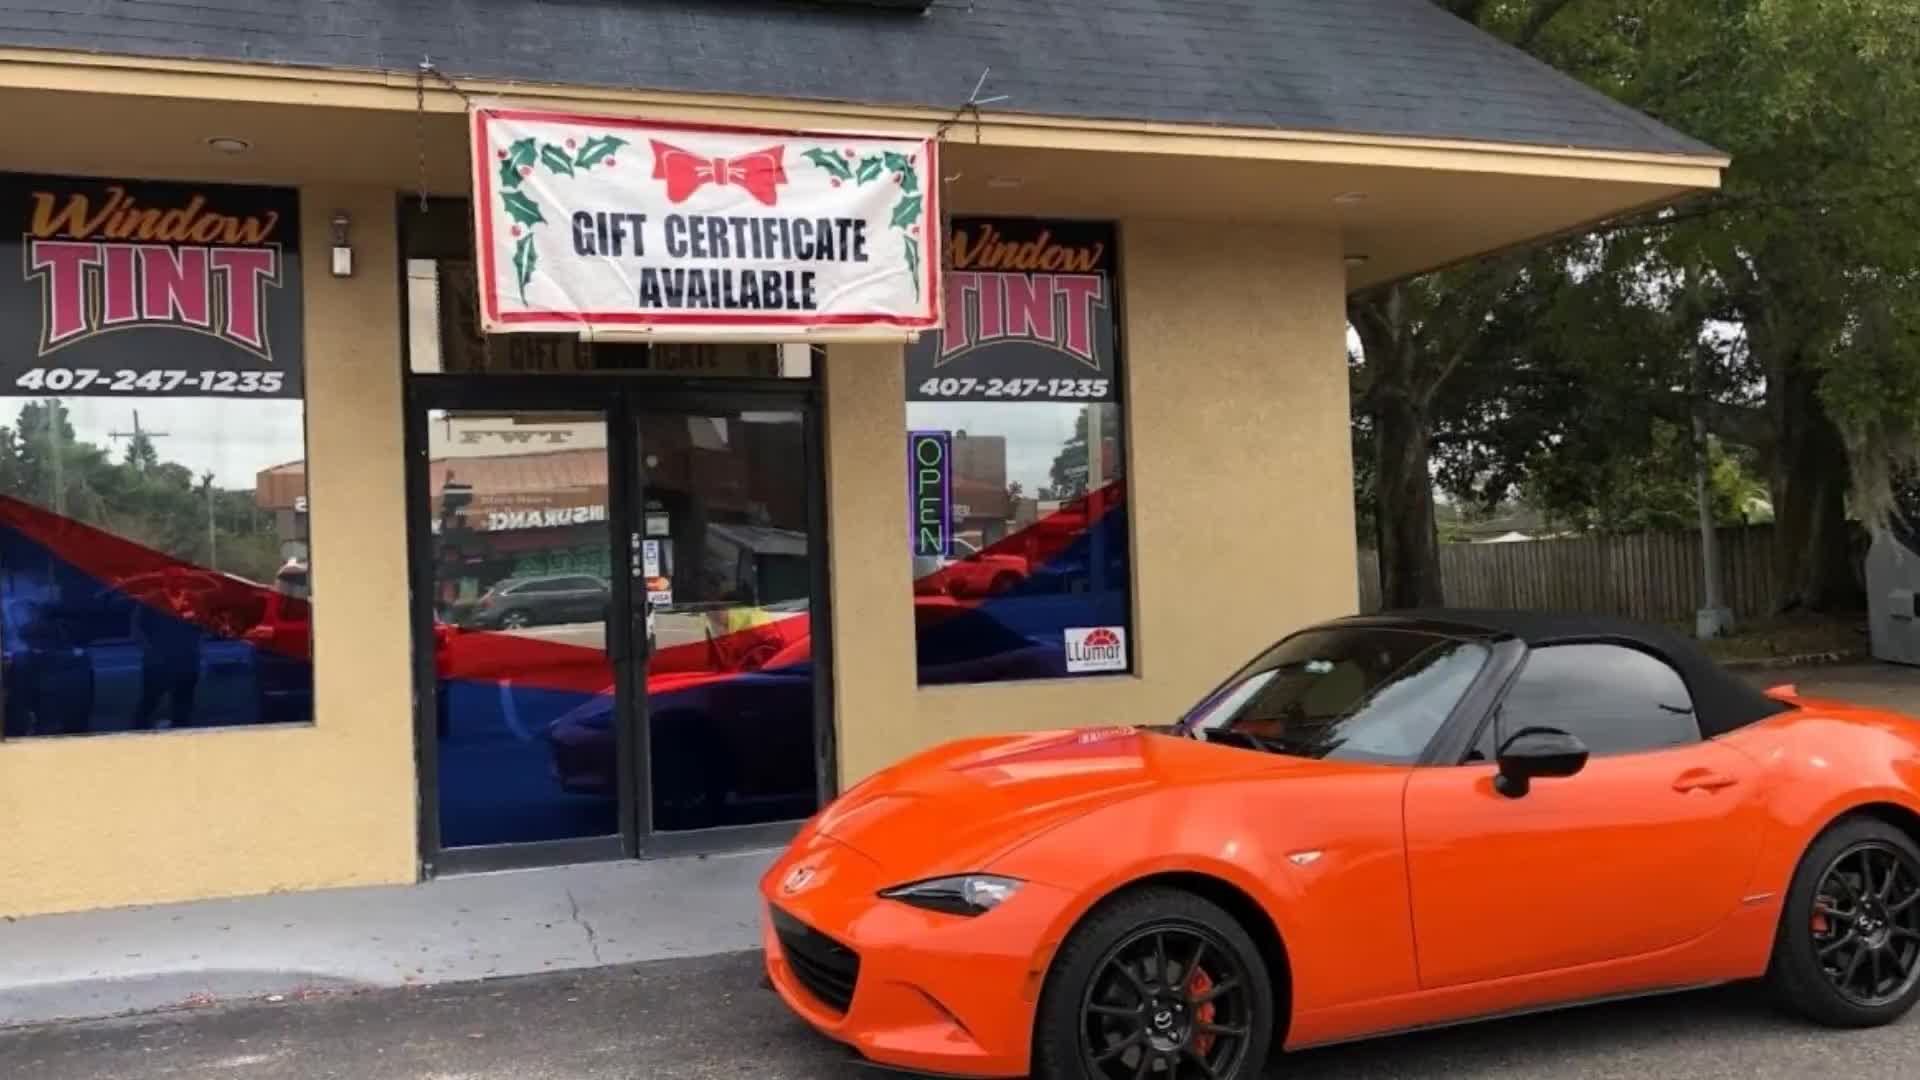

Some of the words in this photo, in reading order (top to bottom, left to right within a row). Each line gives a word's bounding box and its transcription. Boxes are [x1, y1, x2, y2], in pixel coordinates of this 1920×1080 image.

[30, 186, 279, 244] Window
[572, 210, 646, 257] GIFT
[664, 214, 868, 262] CERTIFICATE
[951, 223, 1104, 271] Window
[31, 240, 276, 349] TINT
[639, 268, 817, 310] AVAILABLE
[942, 271, 1101, 359] TINT
[16, 368, 284, 392] 407-247-1235
[919, 378, 1108, 397] 407-247-1235
[916, 438, 942, 553] OPEN
